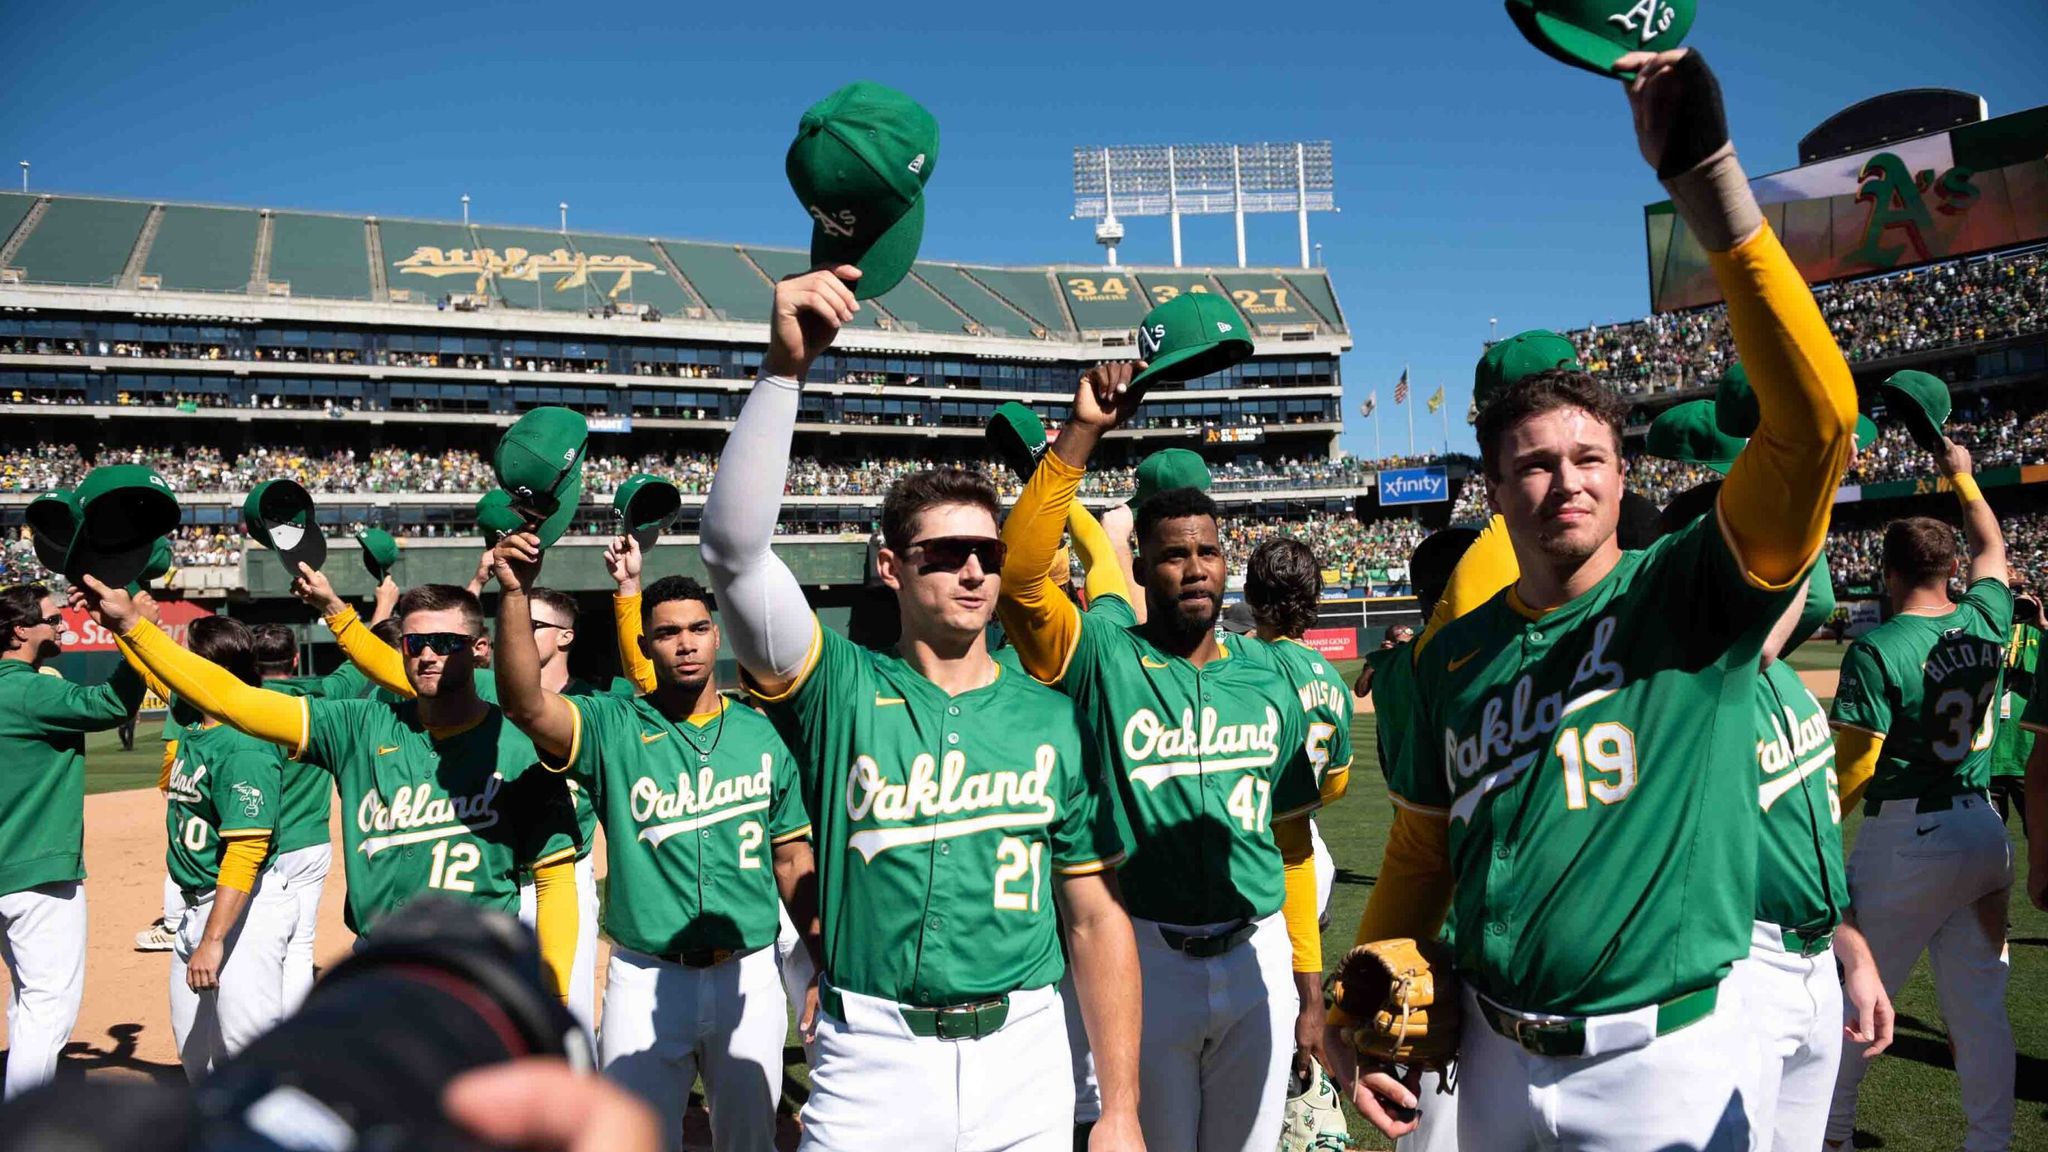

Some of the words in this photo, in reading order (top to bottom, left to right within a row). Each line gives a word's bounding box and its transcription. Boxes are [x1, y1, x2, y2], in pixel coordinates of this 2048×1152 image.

[1608, 0, 1675, 42] A's
[810, 204, 857, 237] A's
[1848, 152, 1980, 267] A's
[1068, 278, 1129, 296] 34
[1232, 288, 1287, 308] 27
[1384, 475, 1442, 497] xfinity
[1298, 679, 1345, 719] WILSON
[1445, 616, 1624, 796] aklad
[1123, 705, 1279, 761] Oakland
[630, 753, 773, 823] Oakland
[847, 744, 1055, 821] Oakland
[1555, 721, 1638, 810] 19
[357, 771, 503, 833] Oakland
[1227, 774, 1271, 833] 47
[429, 839, 481, 893] 12
[738, 820, 763, 869] 2
[994, 836, 1044, 912] 21
